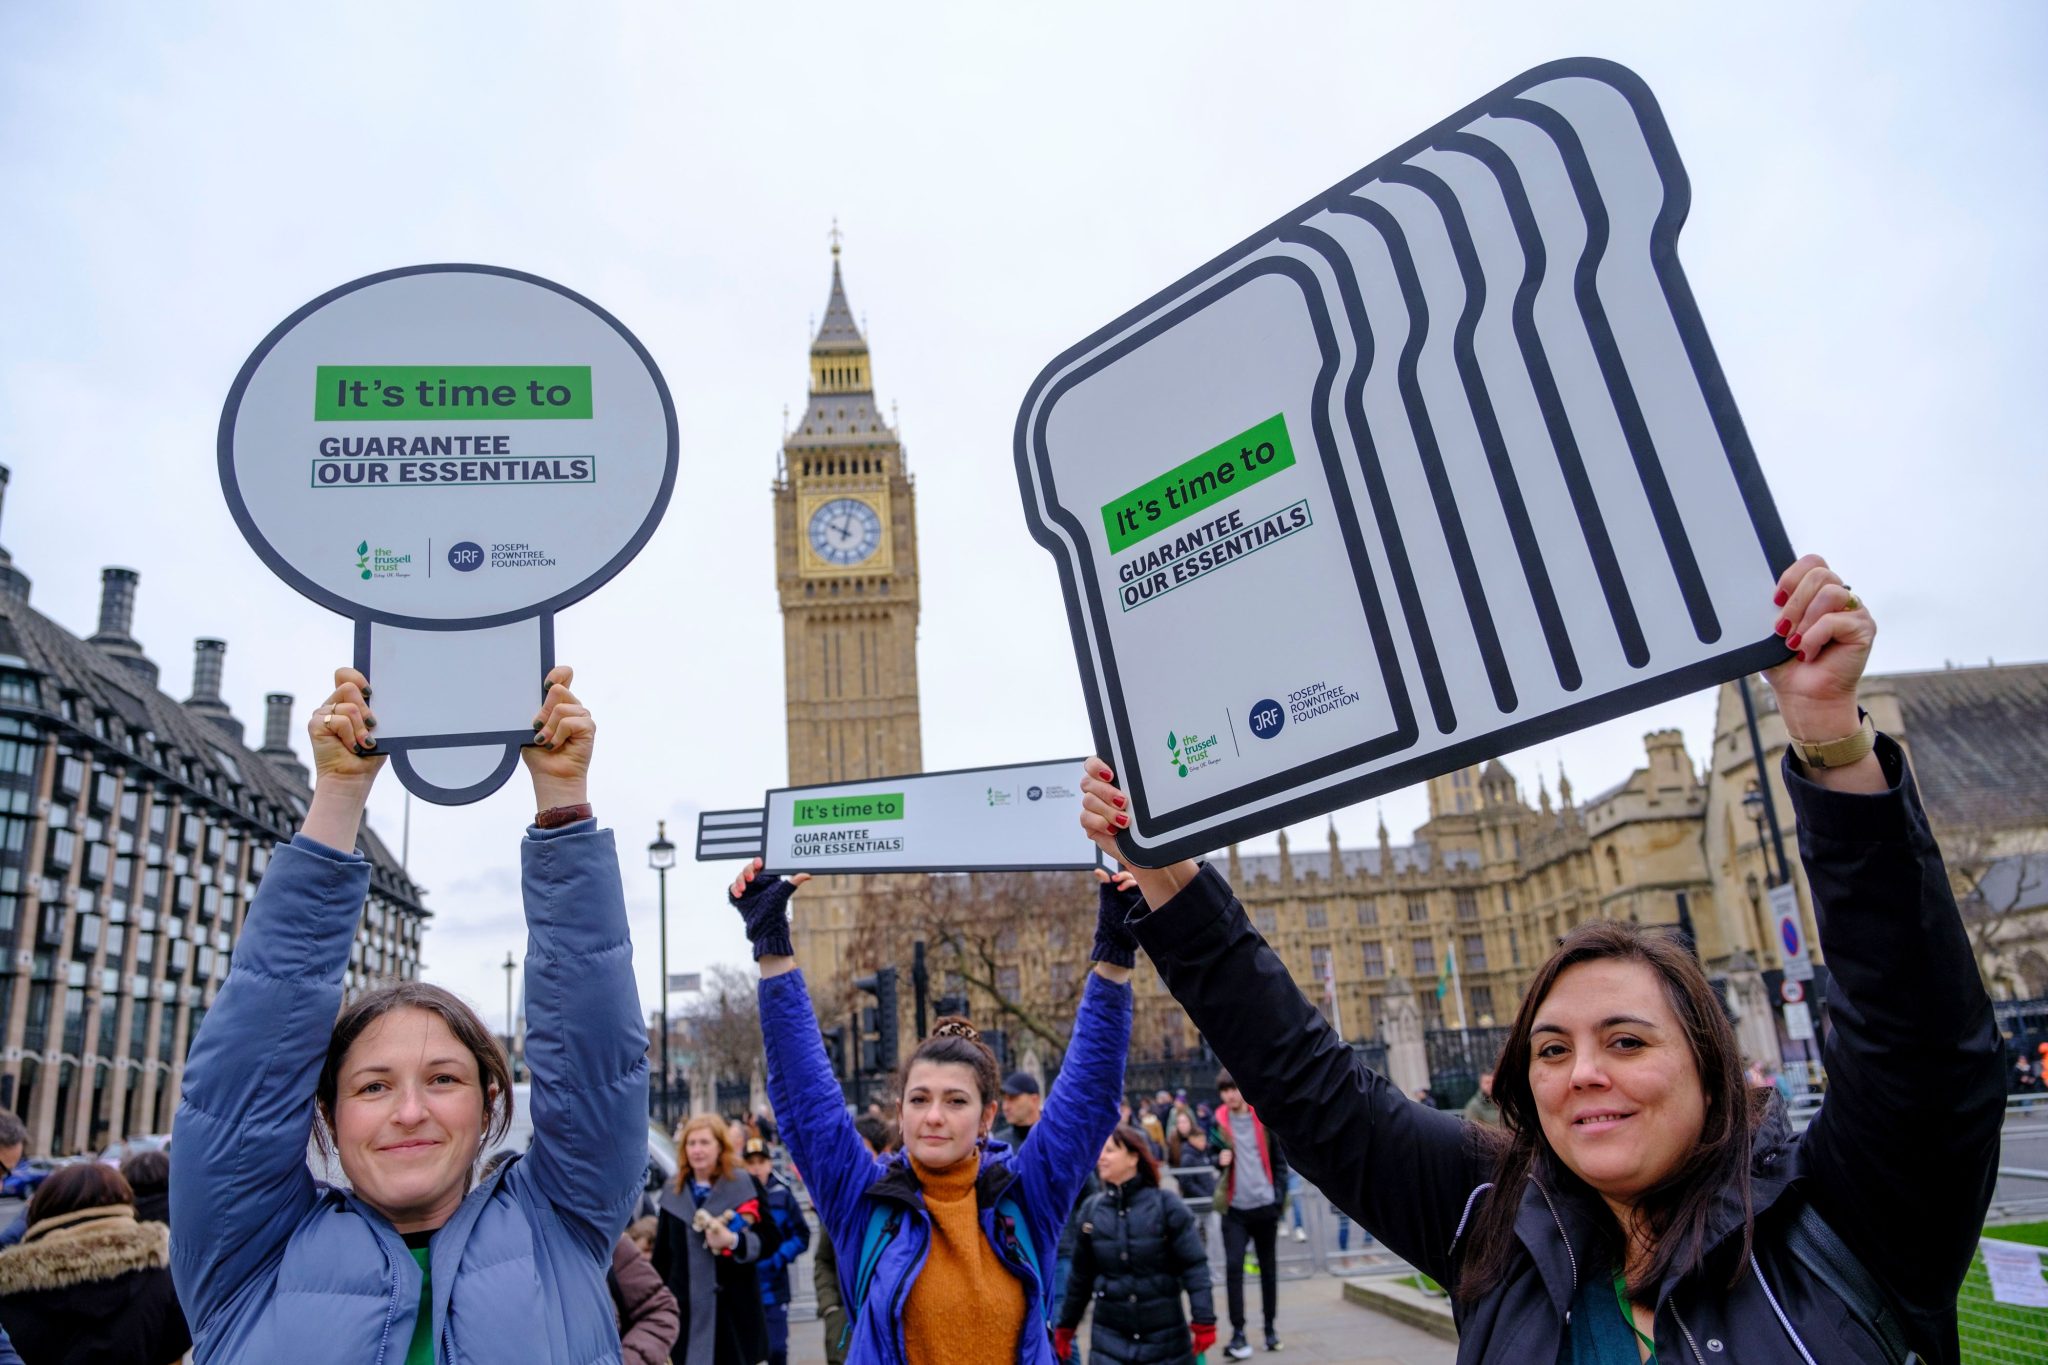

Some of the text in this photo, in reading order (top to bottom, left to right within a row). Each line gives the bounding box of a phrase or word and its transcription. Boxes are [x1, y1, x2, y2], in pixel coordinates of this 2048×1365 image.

[337, 379, 571, 407] It’s time to
[319, 435, 510, 457] GUARANTEE
[318, 460, 589, 484] OUR ESSENTIALS
[1116, 442, 1275, 536] It’s time to
[374, 547, 392, 556] the
[491, 543, 529, 552] JOSEPH
[492, 551, 544, 560] ROWNTREE
[1119, 509, 1244, 583] GUARANTEE
[374, 554, 411, 564] trussell
[453, 550, 479, 564] JRF
[492, 559, 556, 568] FOUNDATION
[1124, 507, 1306, 606] OUR ESSENTIALS
[1288, 681, 1326, 704] JOSEPH
[1291, 685, 1346, 713] ROWNTREE
[1293, 691, 1360, 724] FOUNDATION
[1254, 708, 1278, 731] JRF
[1182, 735, 1198, 746] the
[1185, 734, 1217, 755] trussell
[1187, 750, 1208, 764] trust
[802, 801, 895, 820] It’s time to
[794, 829, 869, 844] GUARANTEE
[794, 839, 900, 856] OUR ESSENTIALS
